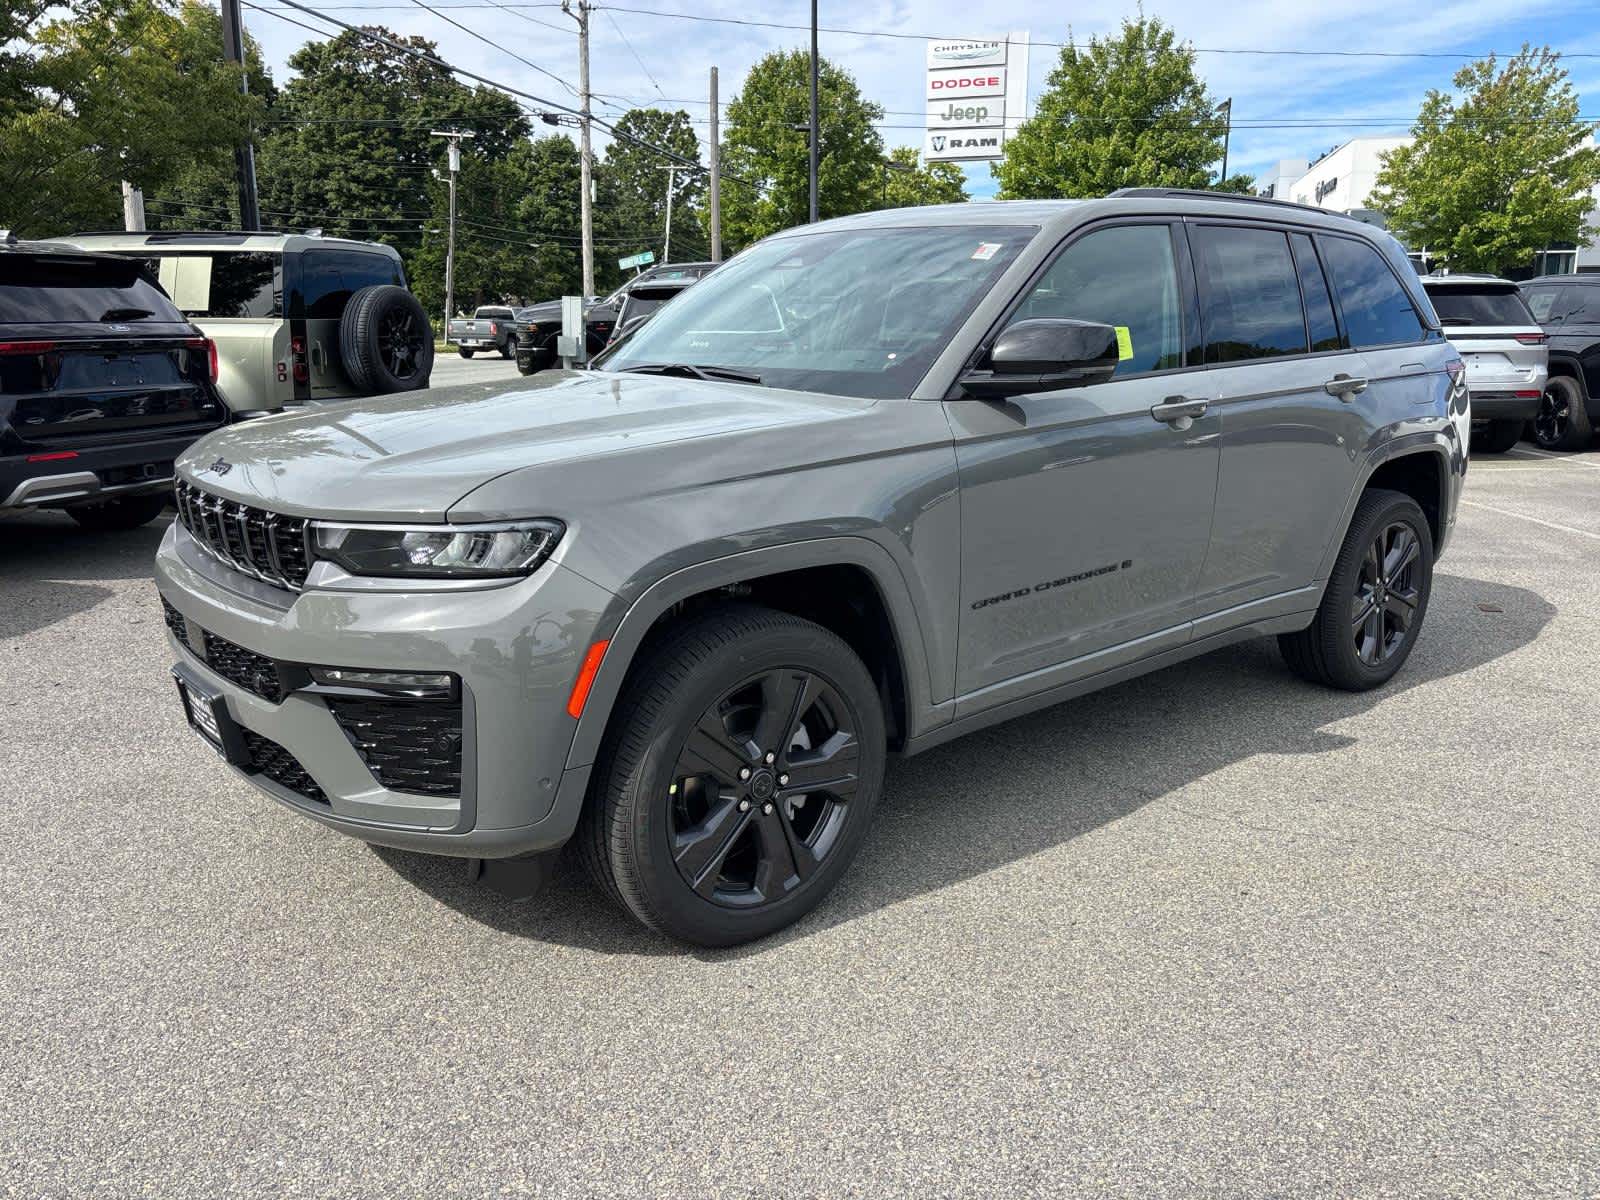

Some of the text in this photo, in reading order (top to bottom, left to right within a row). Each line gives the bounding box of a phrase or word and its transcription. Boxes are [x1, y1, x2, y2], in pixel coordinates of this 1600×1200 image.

[934, 41, 999, 52] CHRYSLER
[931, 77, 1000, 90] DODGE
[941, 104, 988, 122] Jeep
[950, 138, 997, 148] RAM
[971, 564, 1118, 610] GRAND CHEROKEE
